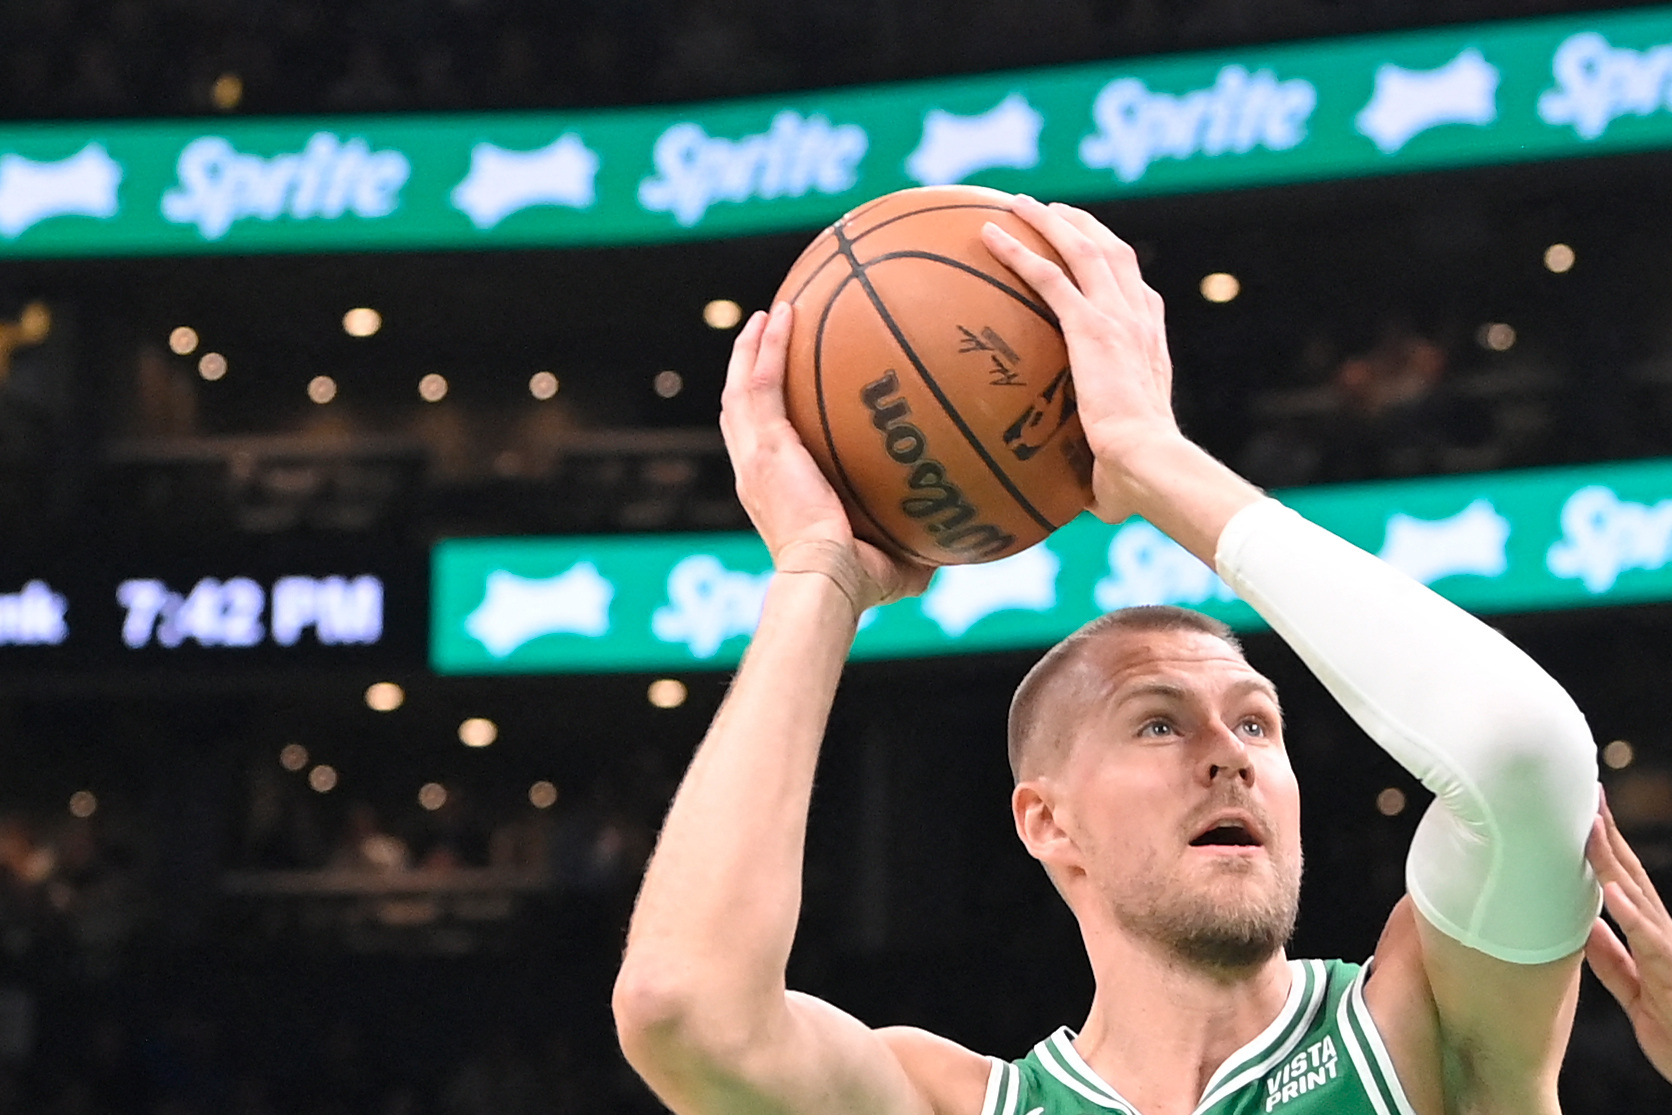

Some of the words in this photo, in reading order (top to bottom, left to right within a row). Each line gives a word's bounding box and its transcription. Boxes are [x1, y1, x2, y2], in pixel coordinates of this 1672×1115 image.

[163, 132, 408, 238] Sprite
[638, 109, 868, 226] Sprite
[1079, 65, 1317, 182] Sprite
[117, 578, 264, 648] 7:42
[272, 575, 383, 646] PM
[1265, 1056, 1338, 1113] PRINT
[1267, 1034, 1337, 1095] VISTA
